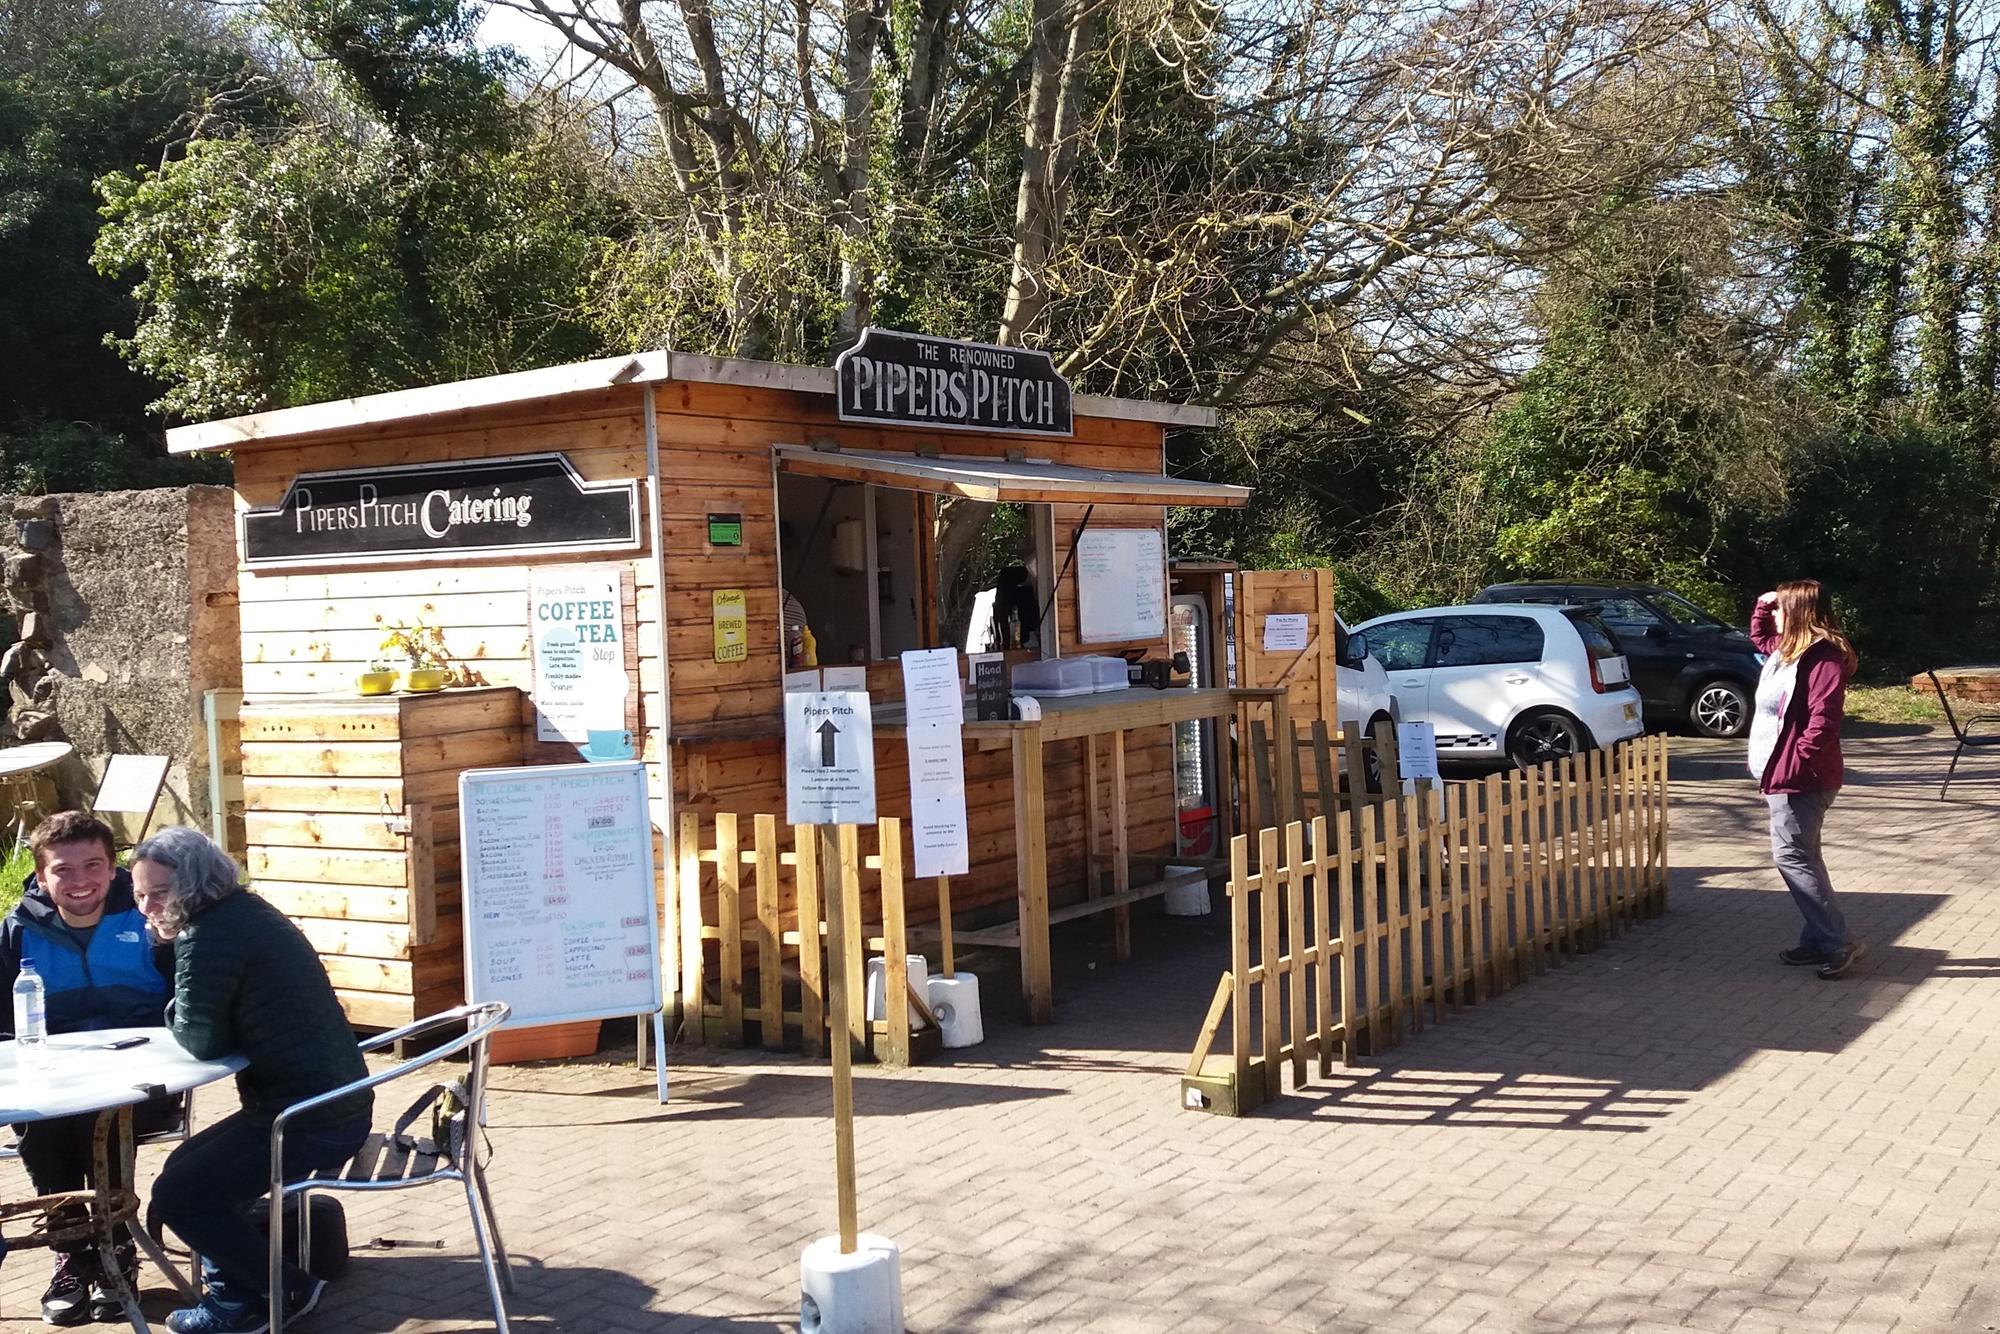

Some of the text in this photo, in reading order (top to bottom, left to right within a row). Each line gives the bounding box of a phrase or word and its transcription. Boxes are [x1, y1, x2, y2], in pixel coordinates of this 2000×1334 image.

[916, 342, 1016, 370] THE RENOWNED
[420, 487, 533, 539] Catering
[537, 585, 586, 596] Pipers Pitch
[537, 601, 615, 621] COFFEE
[717, 619, 743, 631] BREWED
[575, 623, 618, 643] TEA
[592, 646, 616, 665] Stop
[717, 642, 745, 660] COFFEE
[977, 663, 1002, 676] Hand
[803, 706, 855, 716] Pipers Pitch
[483, 911, 500, 920] NEW
[563, 936, 589, 946] COFFEE
[490, 956, 516, 966] SOUP
[564, 953, 592, 963] LATTE
[490, 973, 523, 983] SCONES
